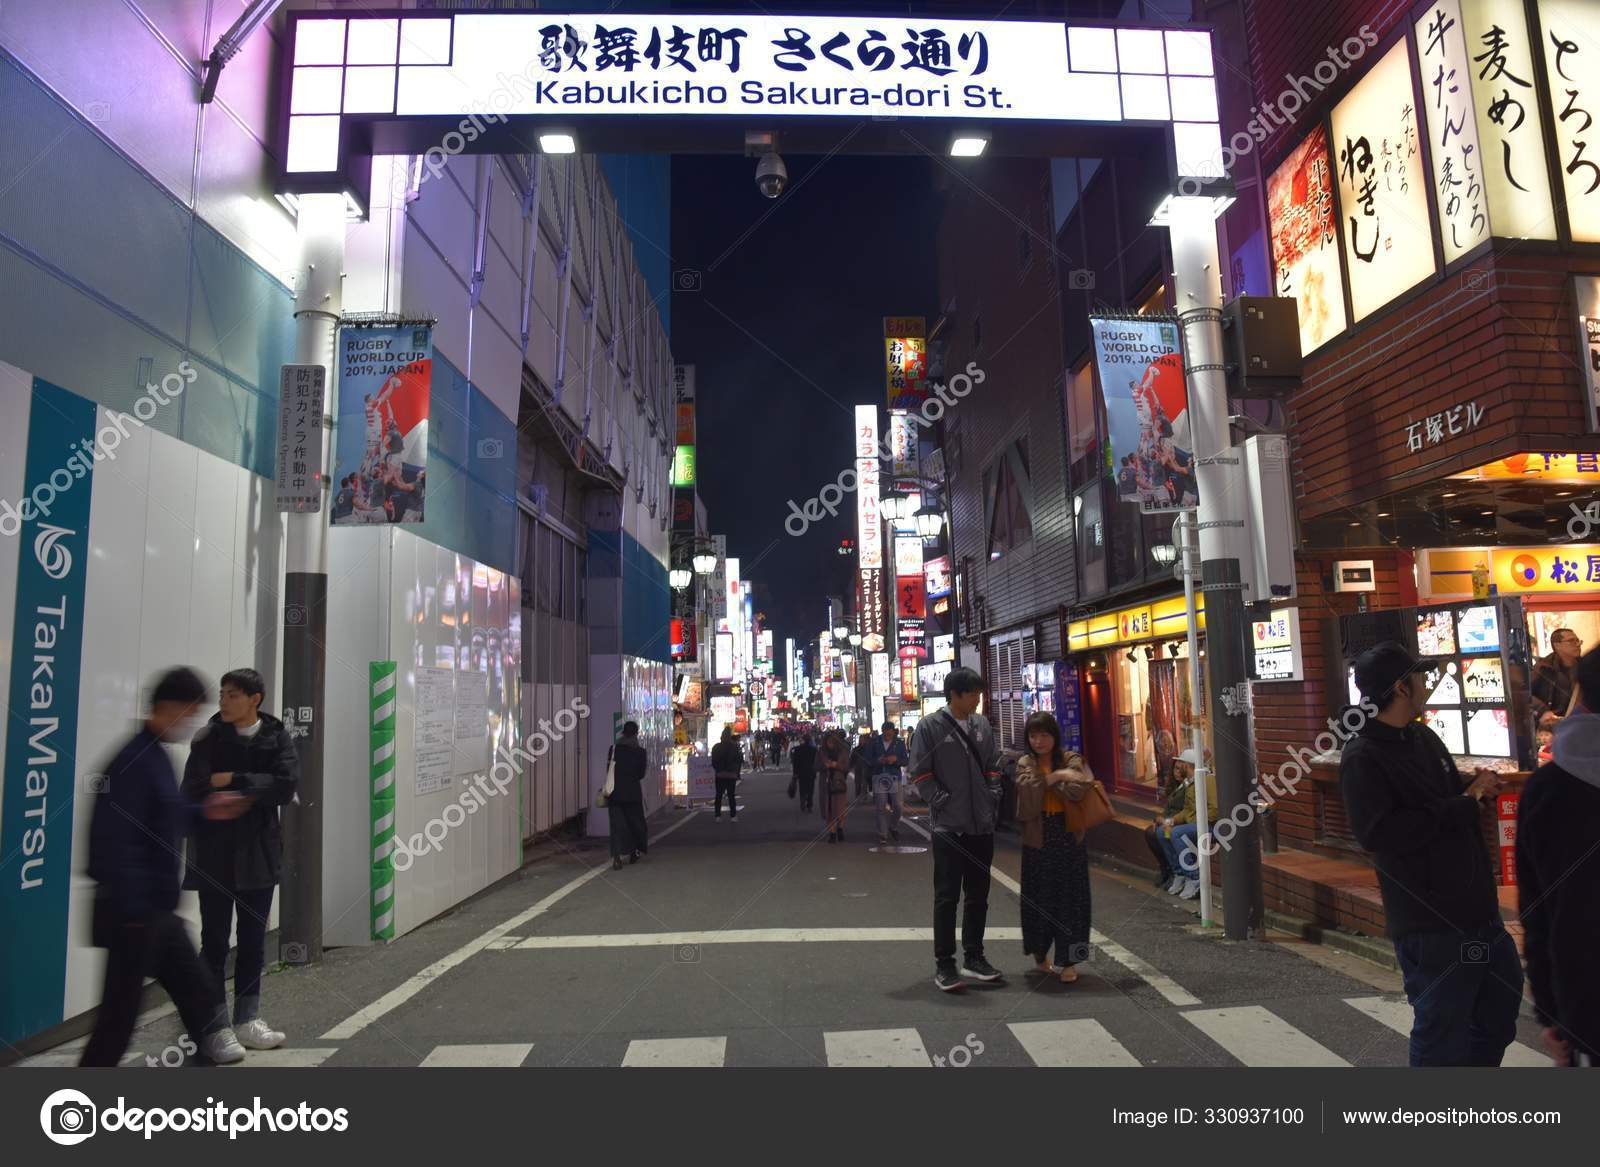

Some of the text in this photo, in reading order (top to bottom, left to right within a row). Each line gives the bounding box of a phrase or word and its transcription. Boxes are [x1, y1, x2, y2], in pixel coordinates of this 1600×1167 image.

[537, 23, 989, 76] 歌舞伎町 さくら通り
[536, 80, 1012, 109] Kabukicho Sakura-dori St.
[1425, 9, 1467, 147] 牛たん
[1474, 24, 1532, 193] 麦めし
[1550, 29, 1600, 195] とろろ
[1340, 136, 1379, 263] ねぎし
[347, 340, 392, 351] RUGBY
[1101, 331, 1143, 342] RUGBY
[1102, 342, 1174, 355] WORLD CUP
[345, 365, 424, 377] 2019, JAPAN
[347, 352, 425, 364] WORLD CUP
[1104, 354, 1177, 367] 2019, JAPAN
[292, 368, 310, 491] 防犯カメラ作動中
[1405, 402, 1484, 453] 石塚ビル
